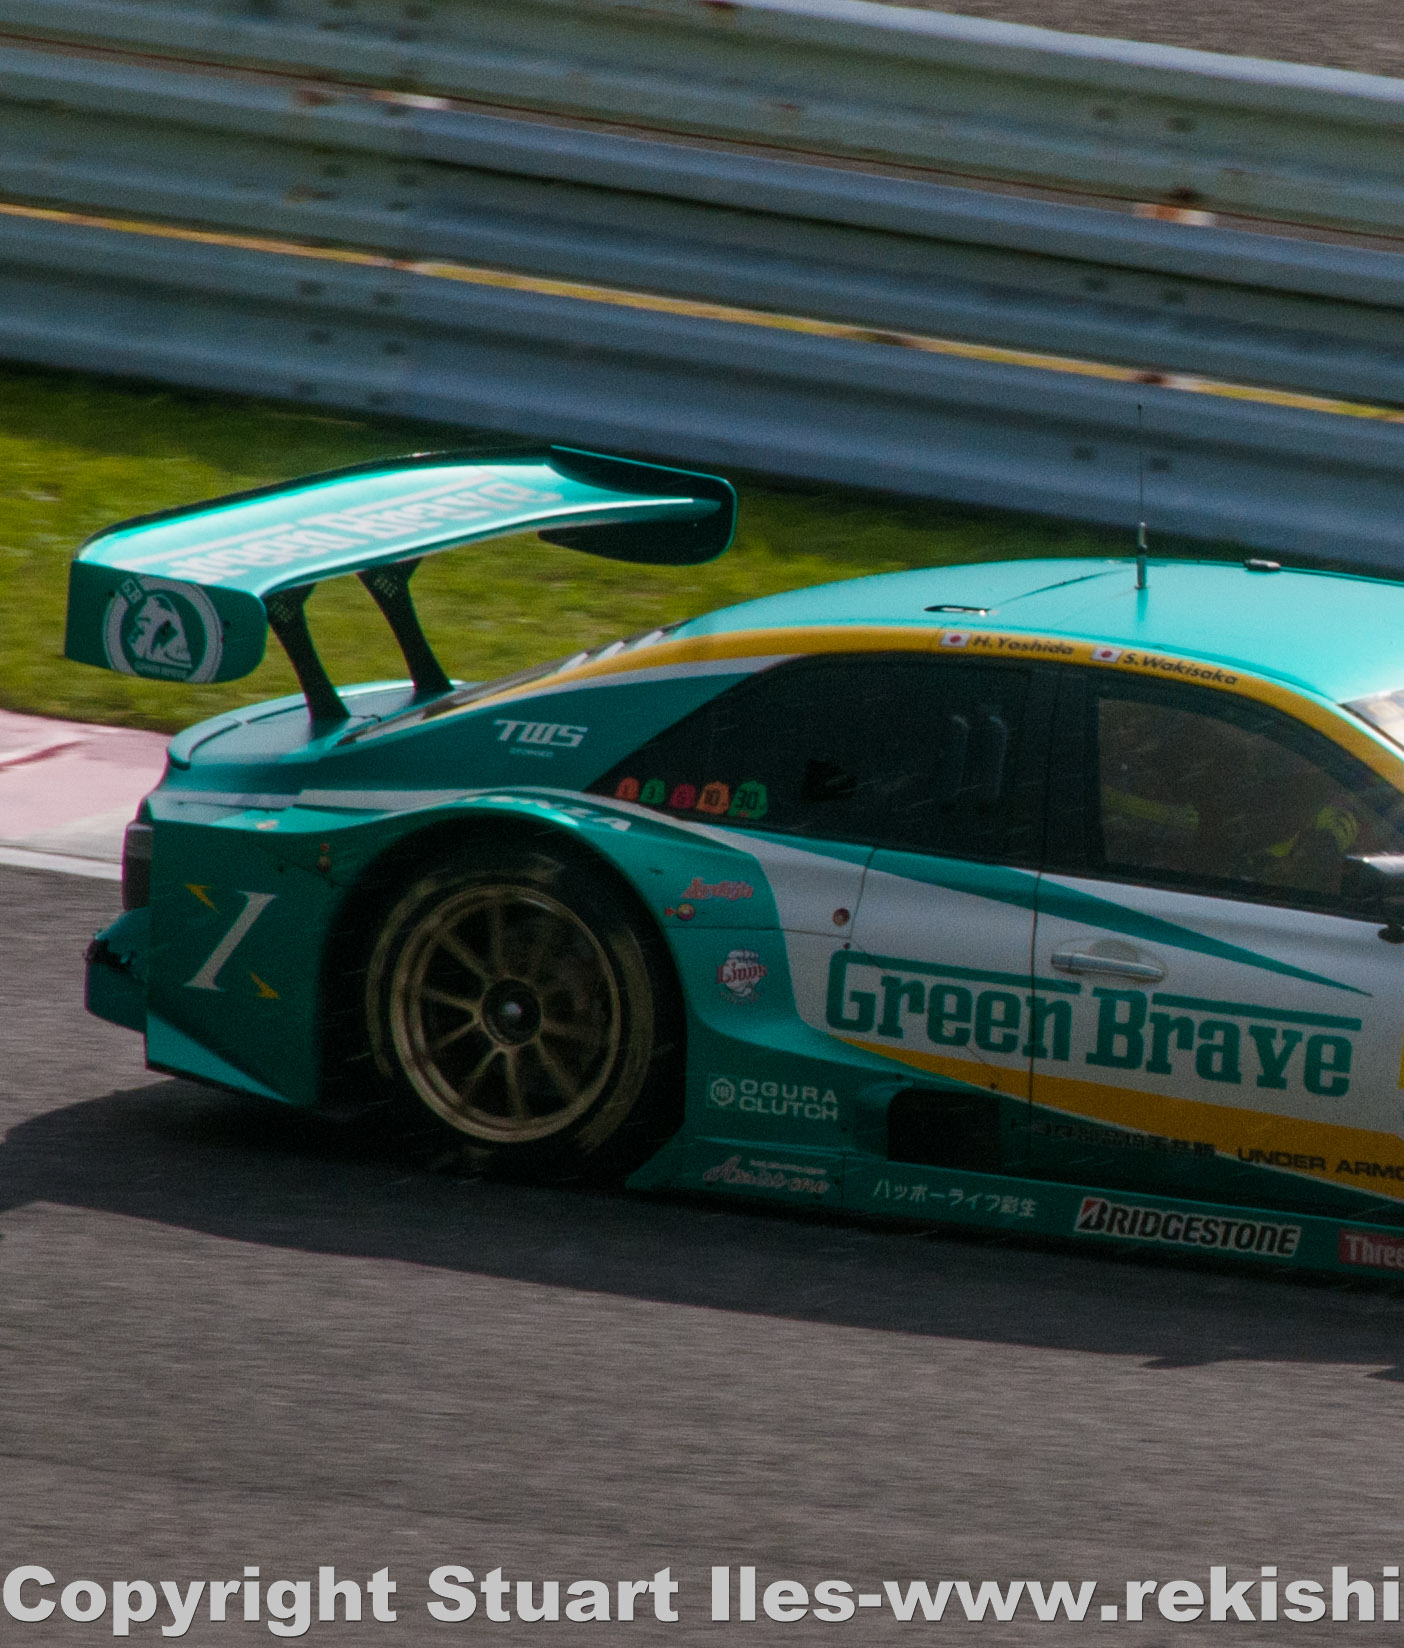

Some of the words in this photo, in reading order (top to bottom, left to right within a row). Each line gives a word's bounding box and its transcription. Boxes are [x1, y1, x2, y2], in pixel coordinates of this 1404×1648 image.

[494, 719, 588, 747] TWS
[735, 789, 758, 810] 30
[826, 949, 1081, 1063] Green
[1085, 986, 1361, 1097] Brave
[740, 1079, 838, 1104] OGURA
[739, 1096, 839, 1121] CLUTCH
[1237, 1148, 1326, 1171] UNDER
[1076, 1198, 1298, 1255] BRIDGESTONE
